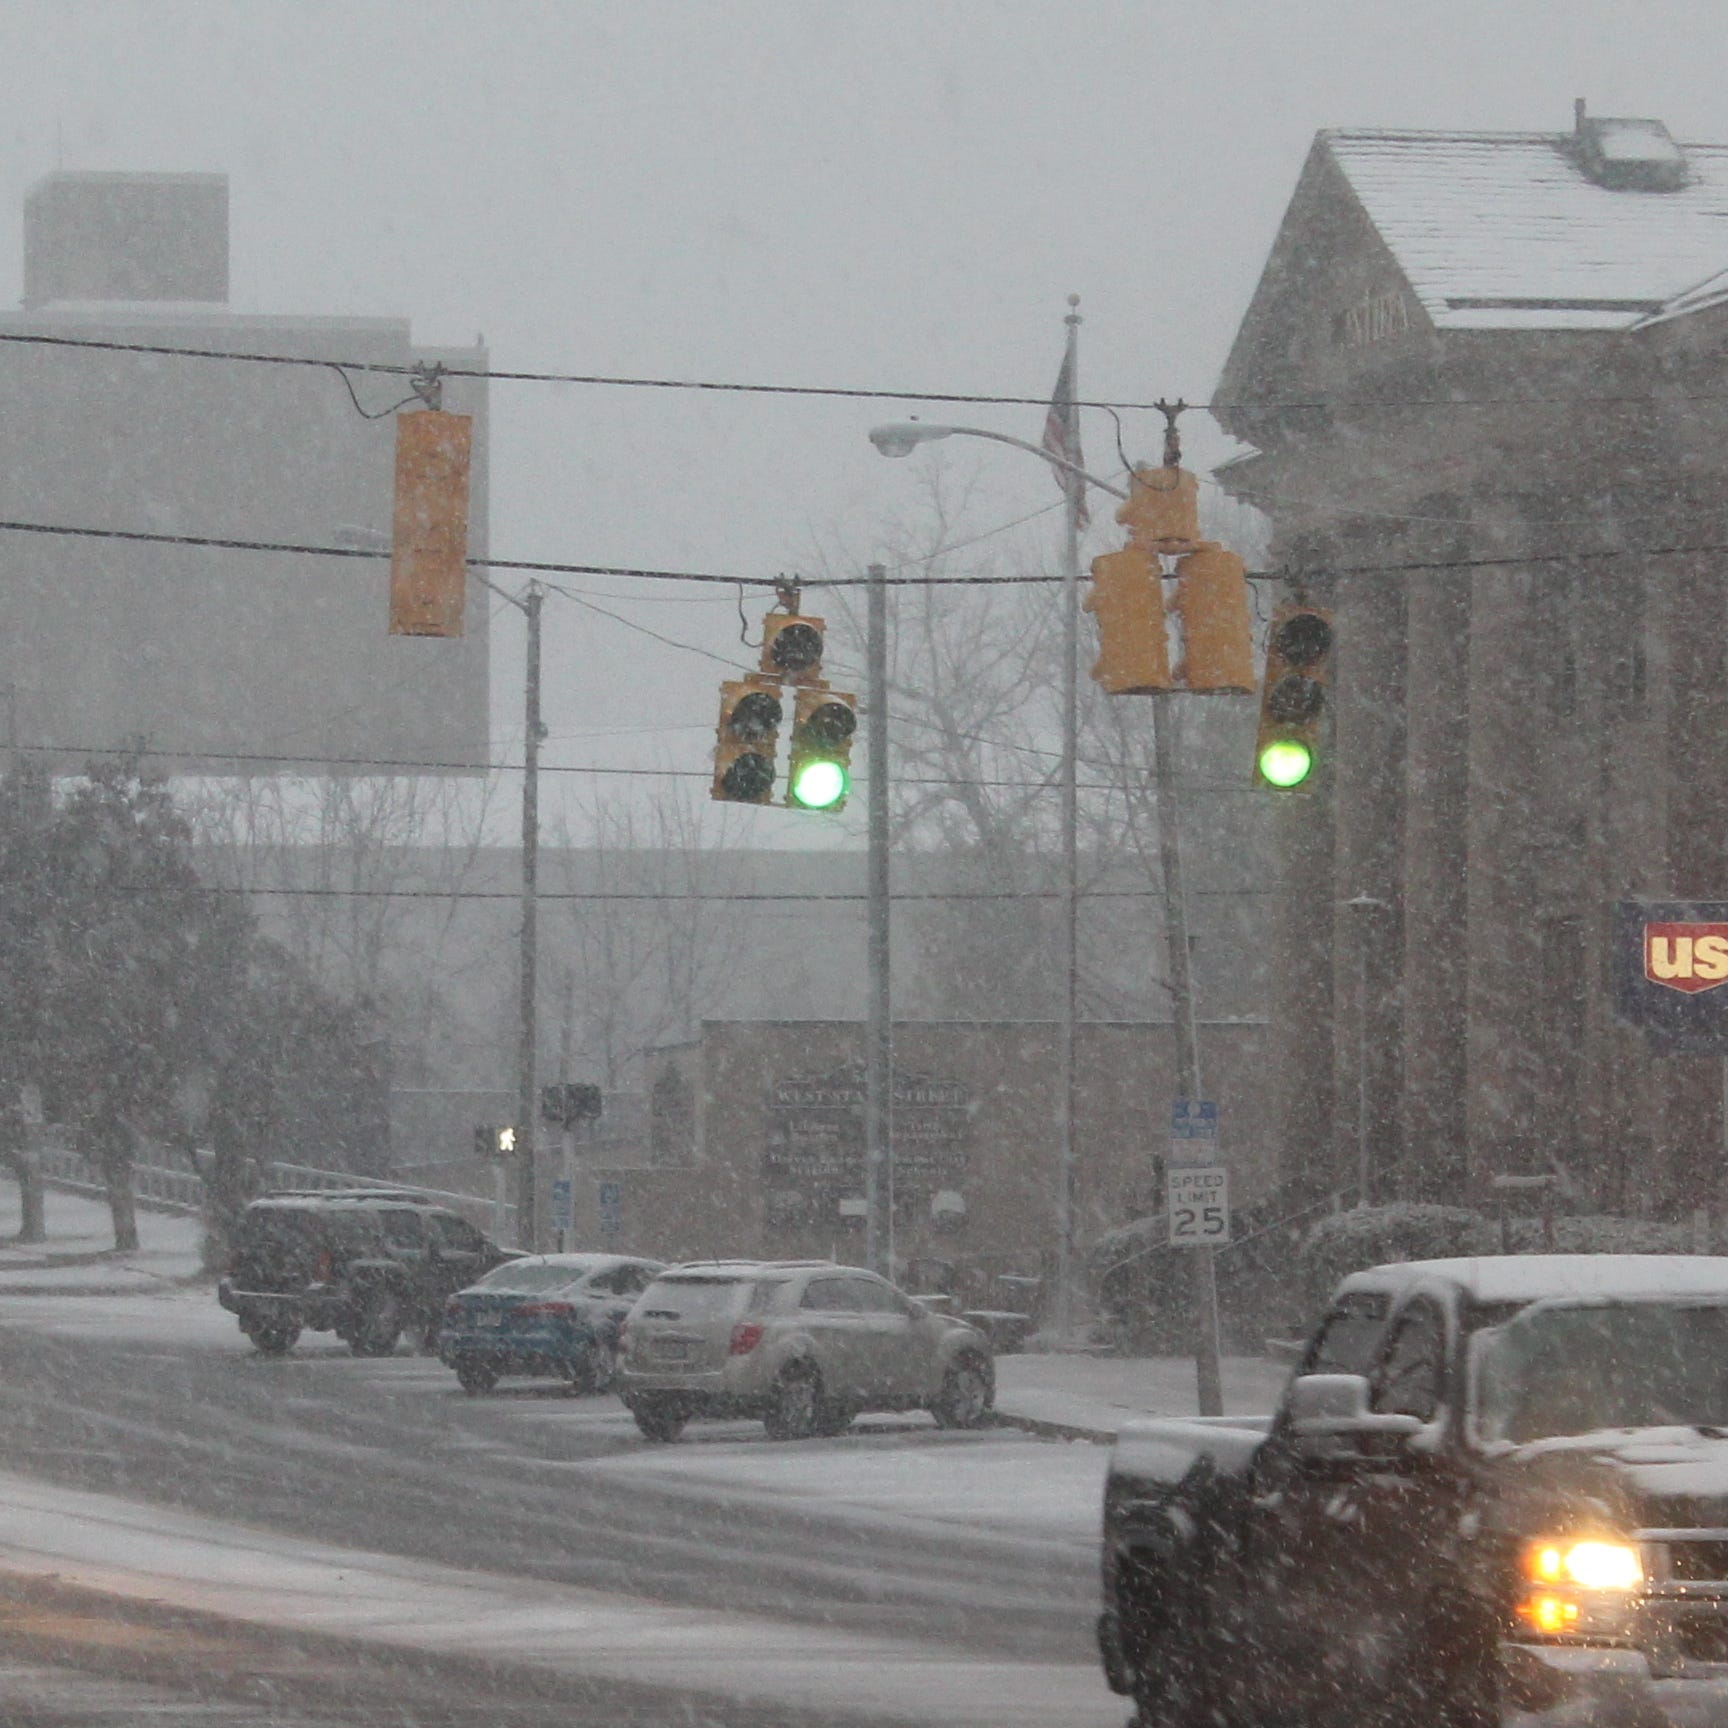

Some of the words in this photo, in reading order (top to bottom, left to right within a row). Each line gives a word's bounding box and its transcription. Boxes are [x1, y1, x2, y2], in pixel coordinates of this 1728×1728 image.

[1172, 1175, 1224, 1189] SPEED
[1177, 1191, 1218, 1203] LIMIT
[1174, 1207, 1225, 1236] 25
